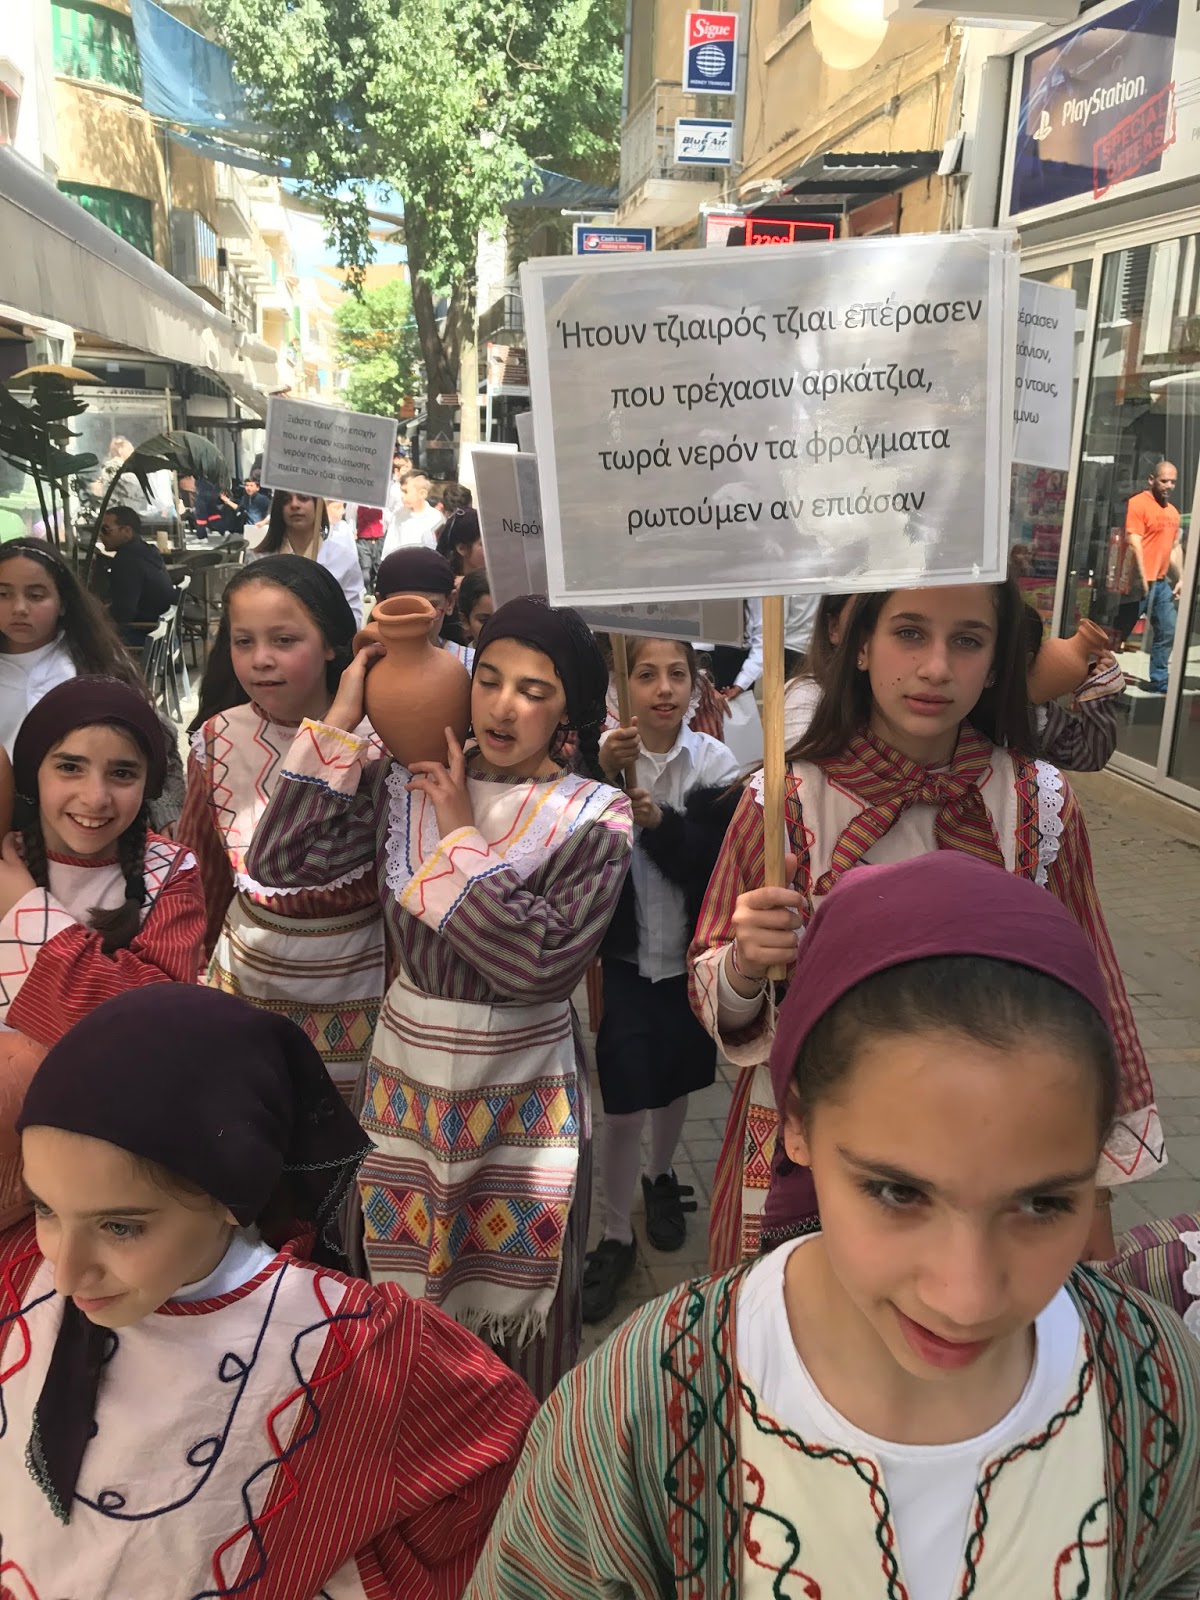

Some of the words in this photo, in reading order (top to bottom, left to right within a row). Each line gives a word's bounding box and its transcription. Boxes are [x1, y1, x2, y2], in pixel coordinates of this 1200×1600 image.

[693, 18, 731, 39] Sigue
[1061, 75, 1146, 127] PlayStation
[682, 135, 708, 147] Blue
[710, 136, 728, 147] Air
[1106, 124, 1165, 180] OFFERS
[615, 235, 628, 243] Line
[556, 319, 647, 349] Ήτουν
[653, 306, 767, 348] τζιαιρός
[772, 305, 837, 340] τζιαι
[844, 297, 983, 333] επέρασεν
[1017, 307, 1059, 330] έρασεν
[611, 385, 665, 409] που
[673, 373, 795, 411] τρέχασιν
[802, 363, 933, 401] αρκάτζια,
[1014, 376, 1024, 390] ο
[1025, 378, 1059, 398] ντους,
[282, 431, 297, 439] που
[348, 427, 376, 439] εποχήν
[282, 447, 305, 458] νερόν
[307, 451, 319, 461] της
[598, 438, 672, 475] τωρά
[678, 434, 759, 471] νερόν
[765, 438, 799, 461] τα
[805, 426, 951, 464] φράγματα
[301, 466, 318, 475] πιον
[628, 497, 763, 535] ρωτούμεν
[770, 500, 804, 520] αν
[811, 487, 926, 518] επιάσαν
